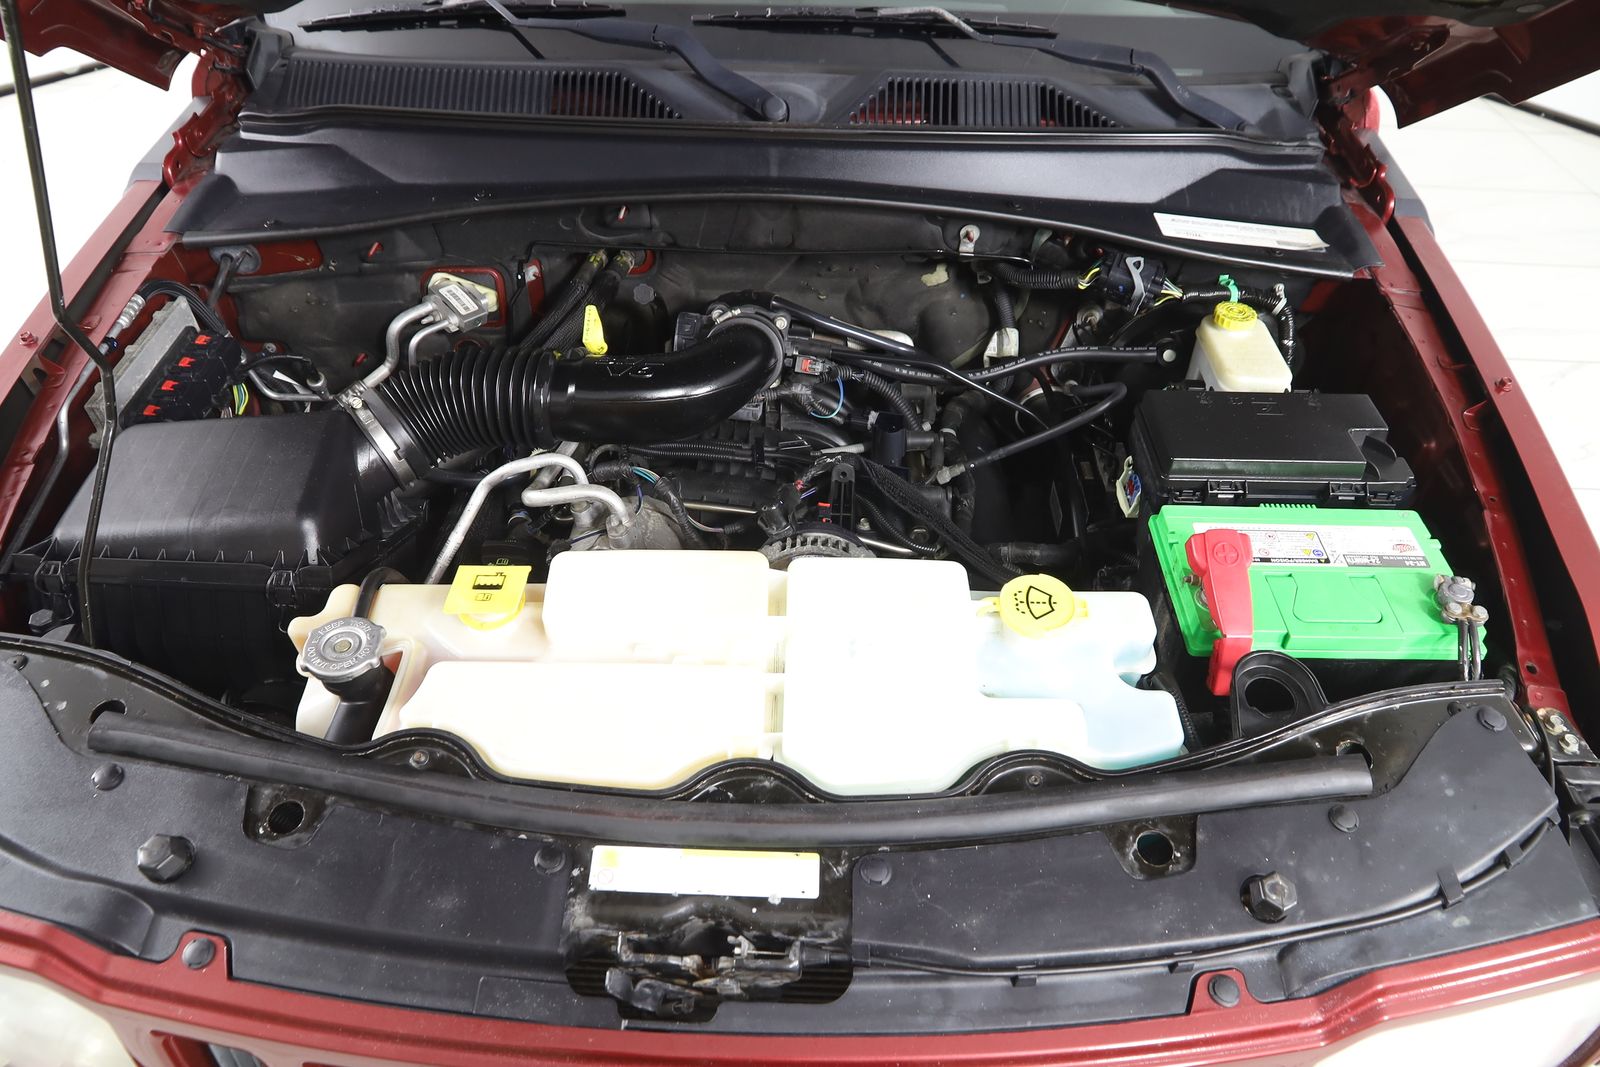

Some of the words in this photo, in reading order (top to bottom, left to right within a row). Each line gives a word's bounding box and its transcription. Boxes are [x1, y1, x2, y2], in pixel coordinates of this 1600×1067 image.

[319, 620, 345, 634] KEEP
[307, 646, 317, 657] DO
[311, 656, 329, 669] NOT
[329, 657, 359, 670] OPEN
